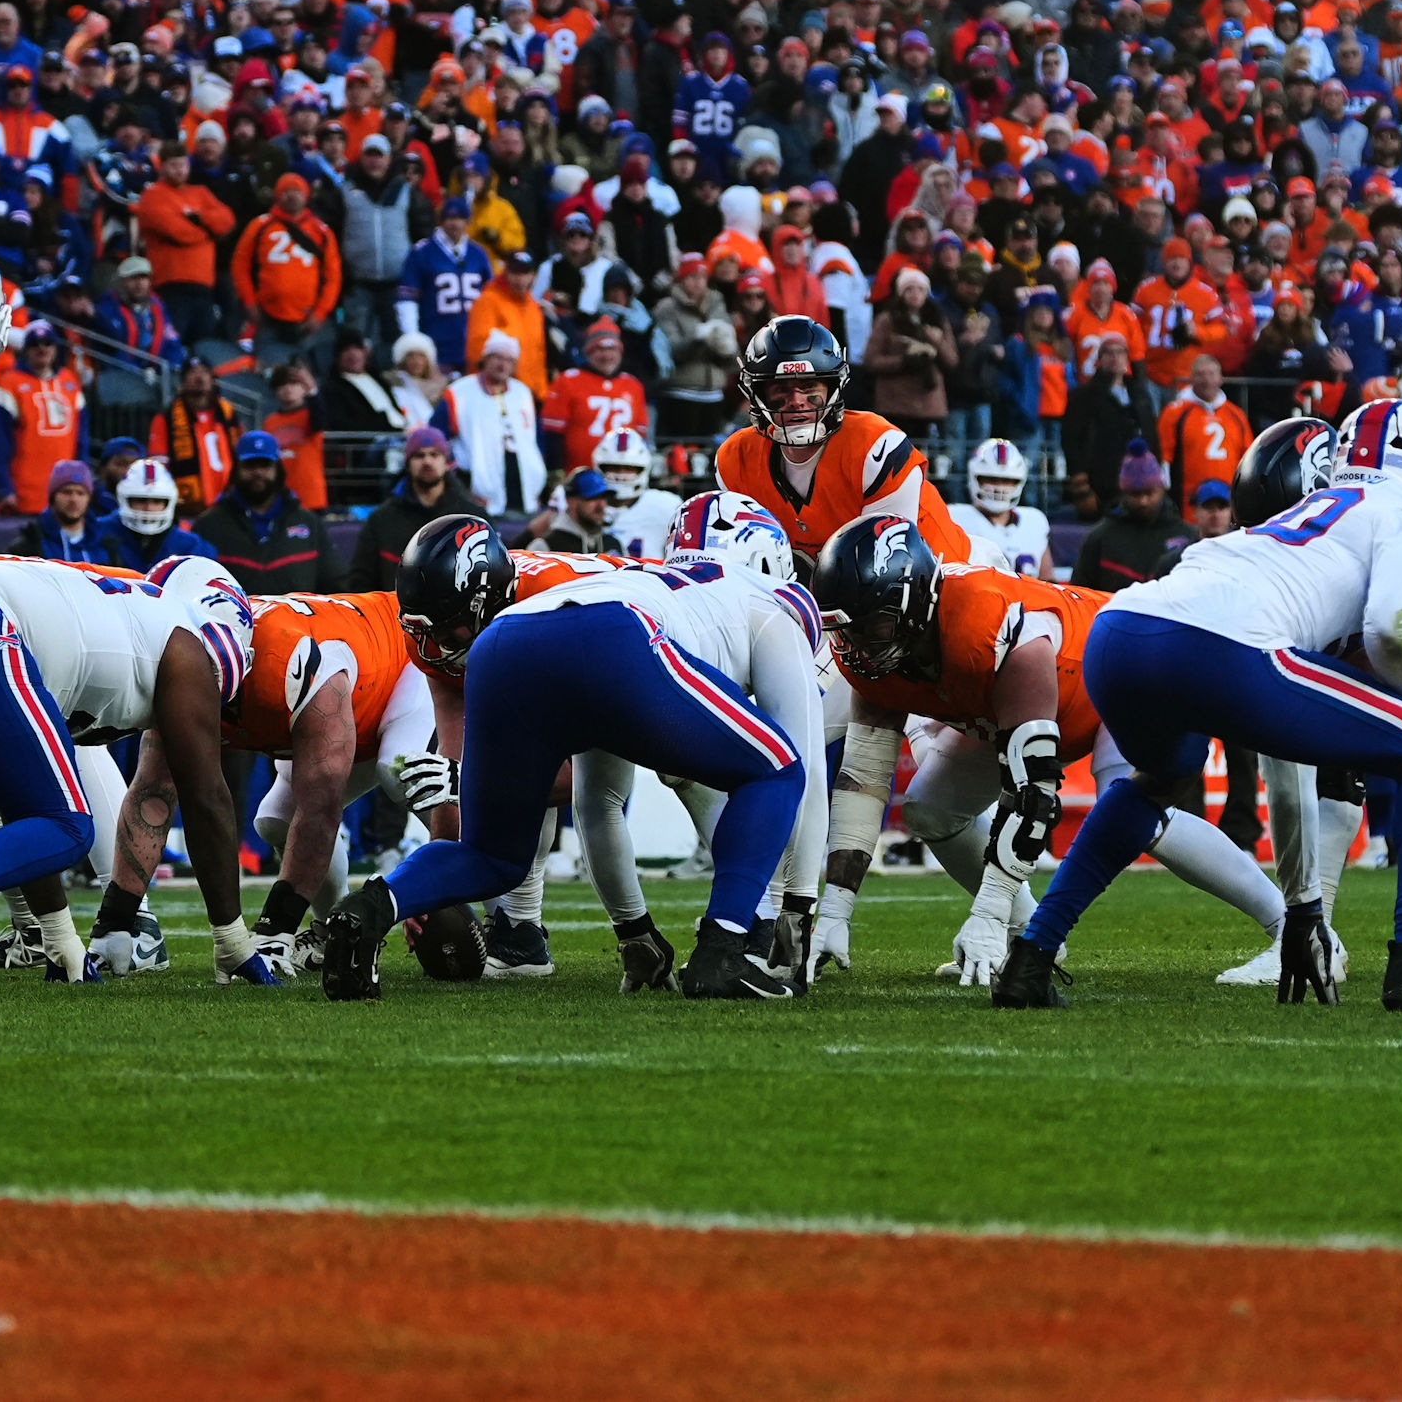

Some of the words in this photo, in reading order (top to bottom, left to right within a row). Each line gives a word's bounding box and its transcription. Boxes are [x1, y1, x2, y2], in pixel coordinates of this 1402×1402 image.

[692, 100, 735, 136] 26
[266, 231, 314, 267] 24
[783, 363, 806, 374] 5280
[587, 396, 634, 436] 72
[1204, 422, 1228, 460] 2
[1335, 472, 1364, 482] CHOOSE
[666, 555, 690, 565] HOOSE
